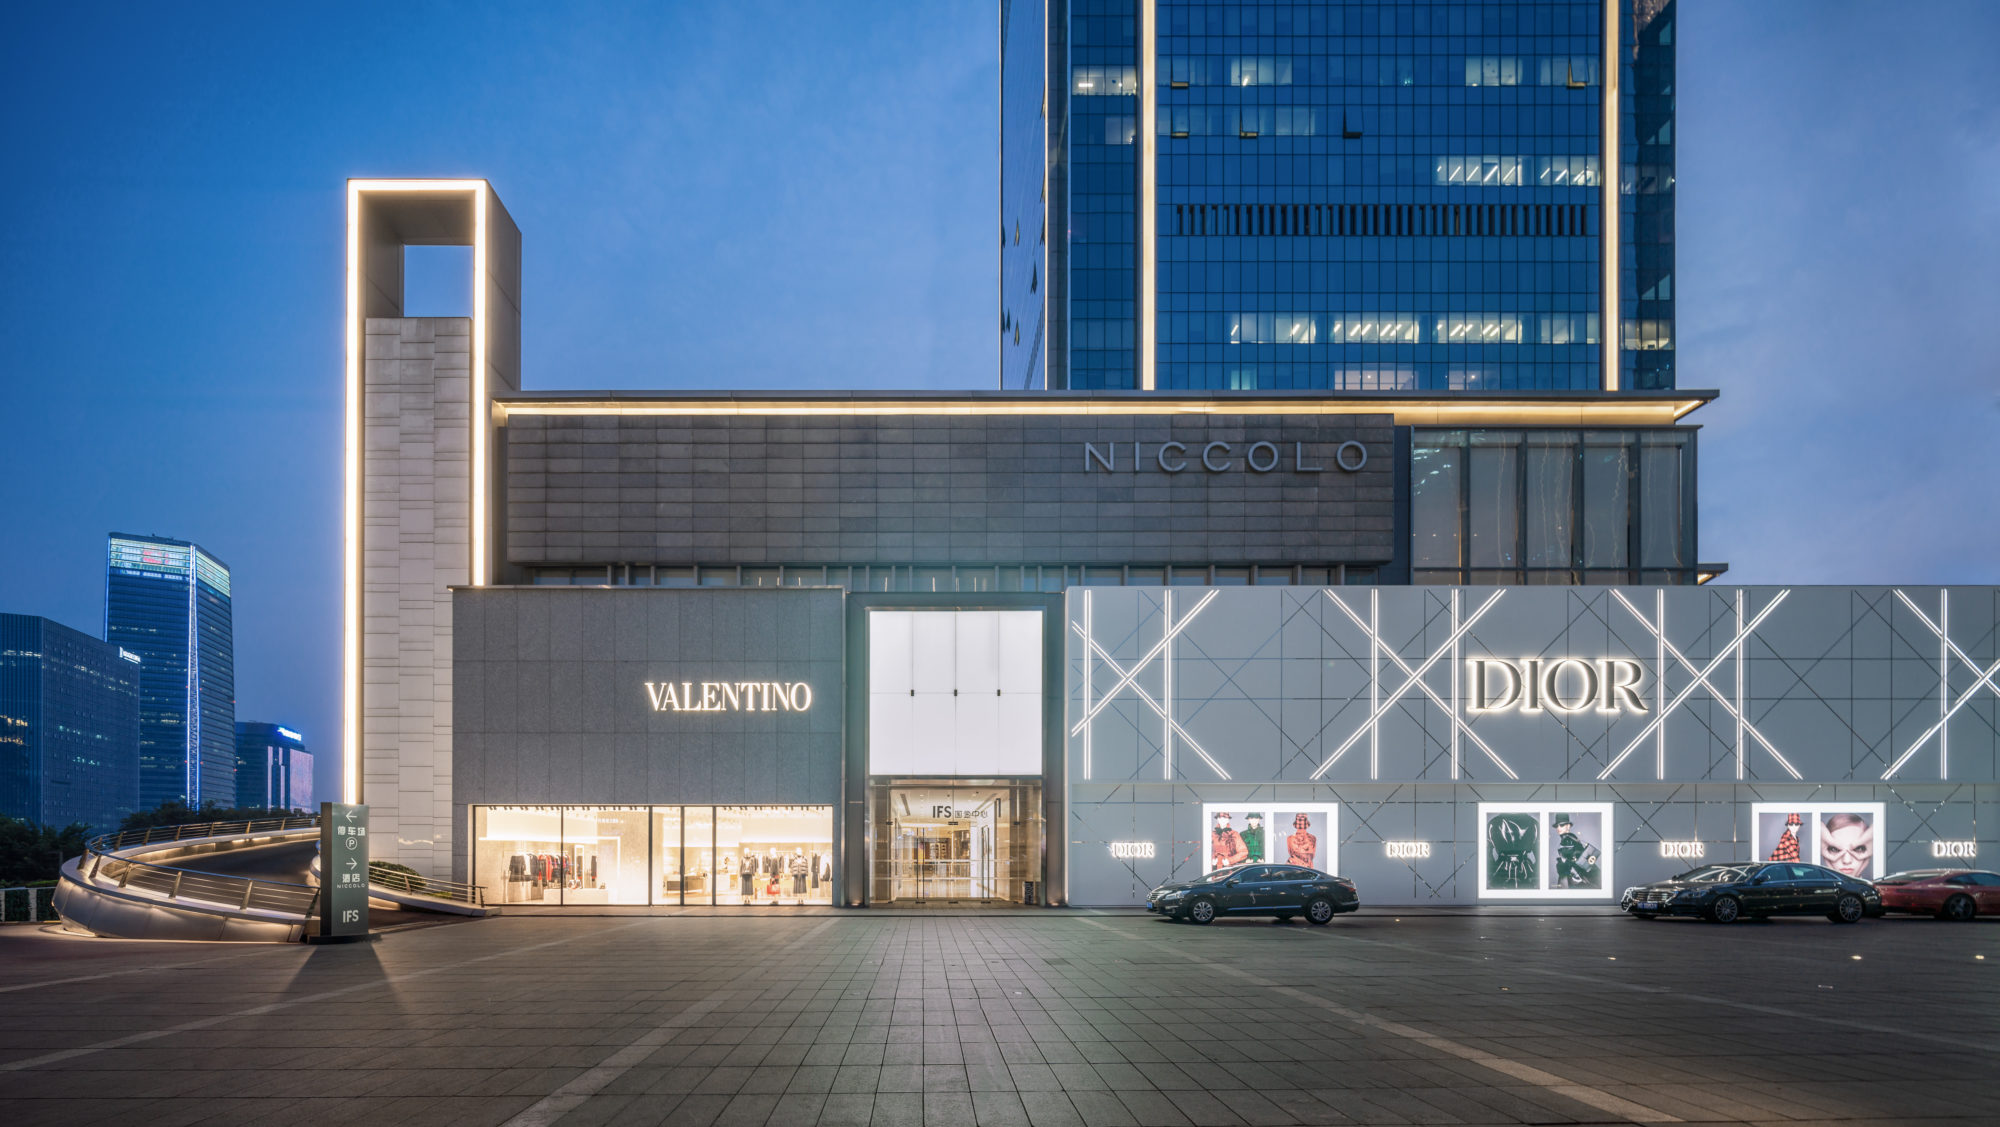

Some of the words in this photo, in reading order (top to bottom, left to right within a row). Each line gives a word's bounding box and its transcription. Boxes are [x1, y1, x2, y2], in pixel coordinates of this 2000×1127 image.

[1085, 440, 1368, 472] NICCOLO
[1466, 658, 1649, 713] DIOR
[645, 682, 812, 712] VALENTINO
[932, 805, 952, 818] IFS
[1111, 842, 1154, 858] DIOR
[1386, 842, 1430, 858] DIOR
[1661, 841, 1704, 858] DIOR
[1933, 841, 1976, 858] DIOR
[342, 873, 361, 883] 酒店
[342, 910, 359, 923] IFS
